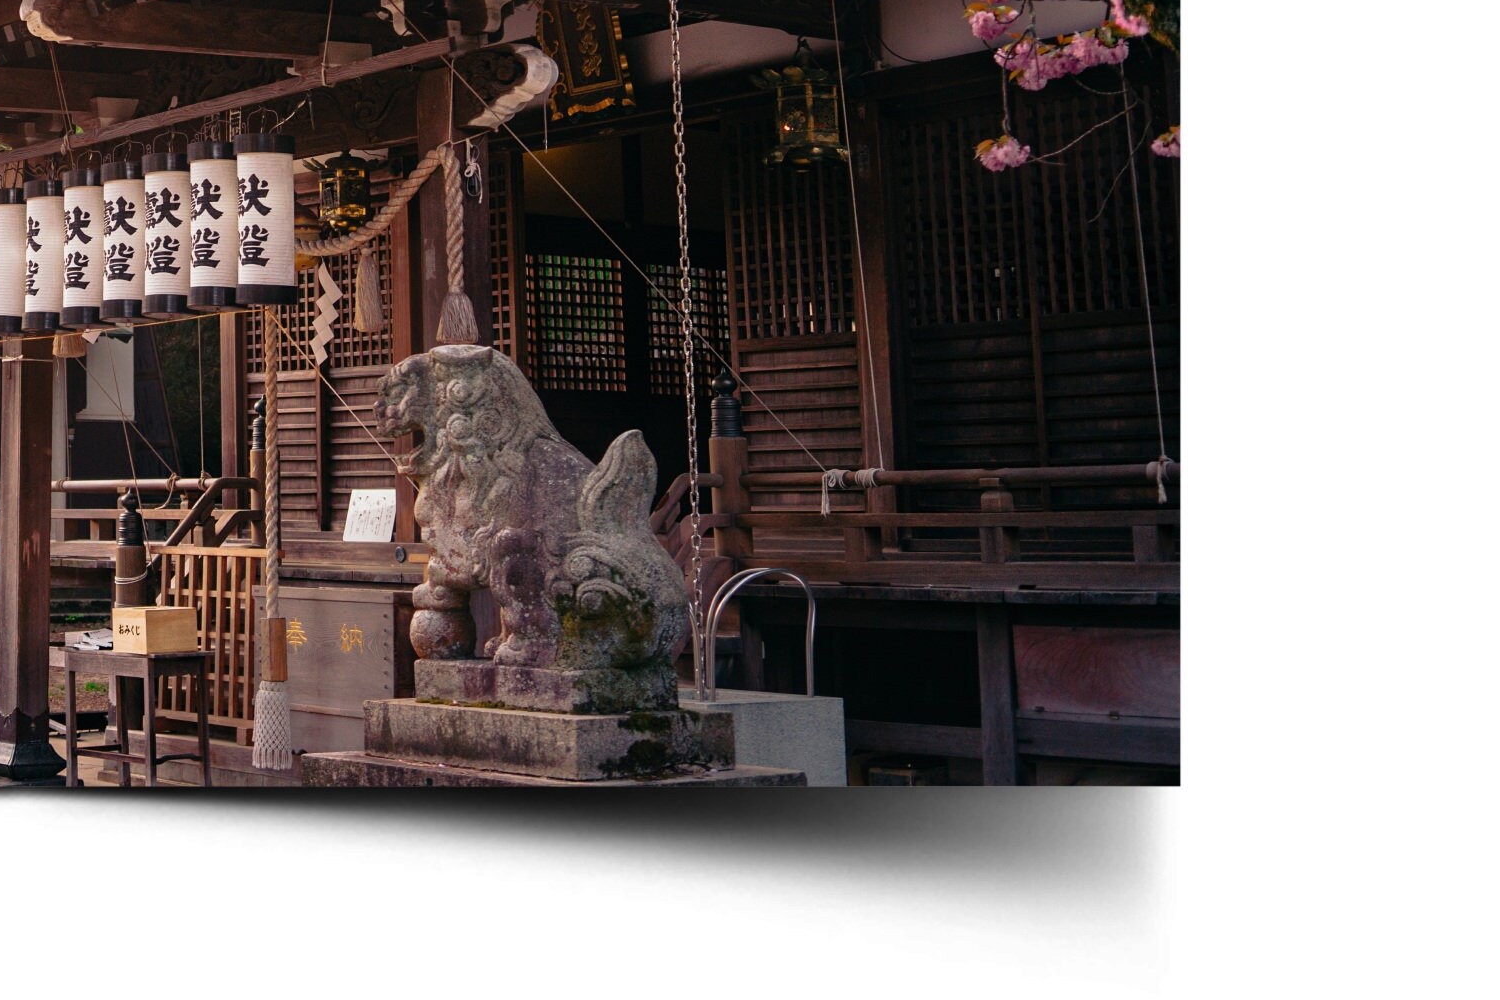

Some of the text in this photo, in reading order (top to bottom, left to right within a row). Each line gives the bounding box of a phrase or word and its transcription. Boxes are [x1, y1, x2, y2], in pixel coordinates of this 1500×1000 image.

[118, 624, 141, 636] おみくじ
[286, 617, 364, 655] 奉納
